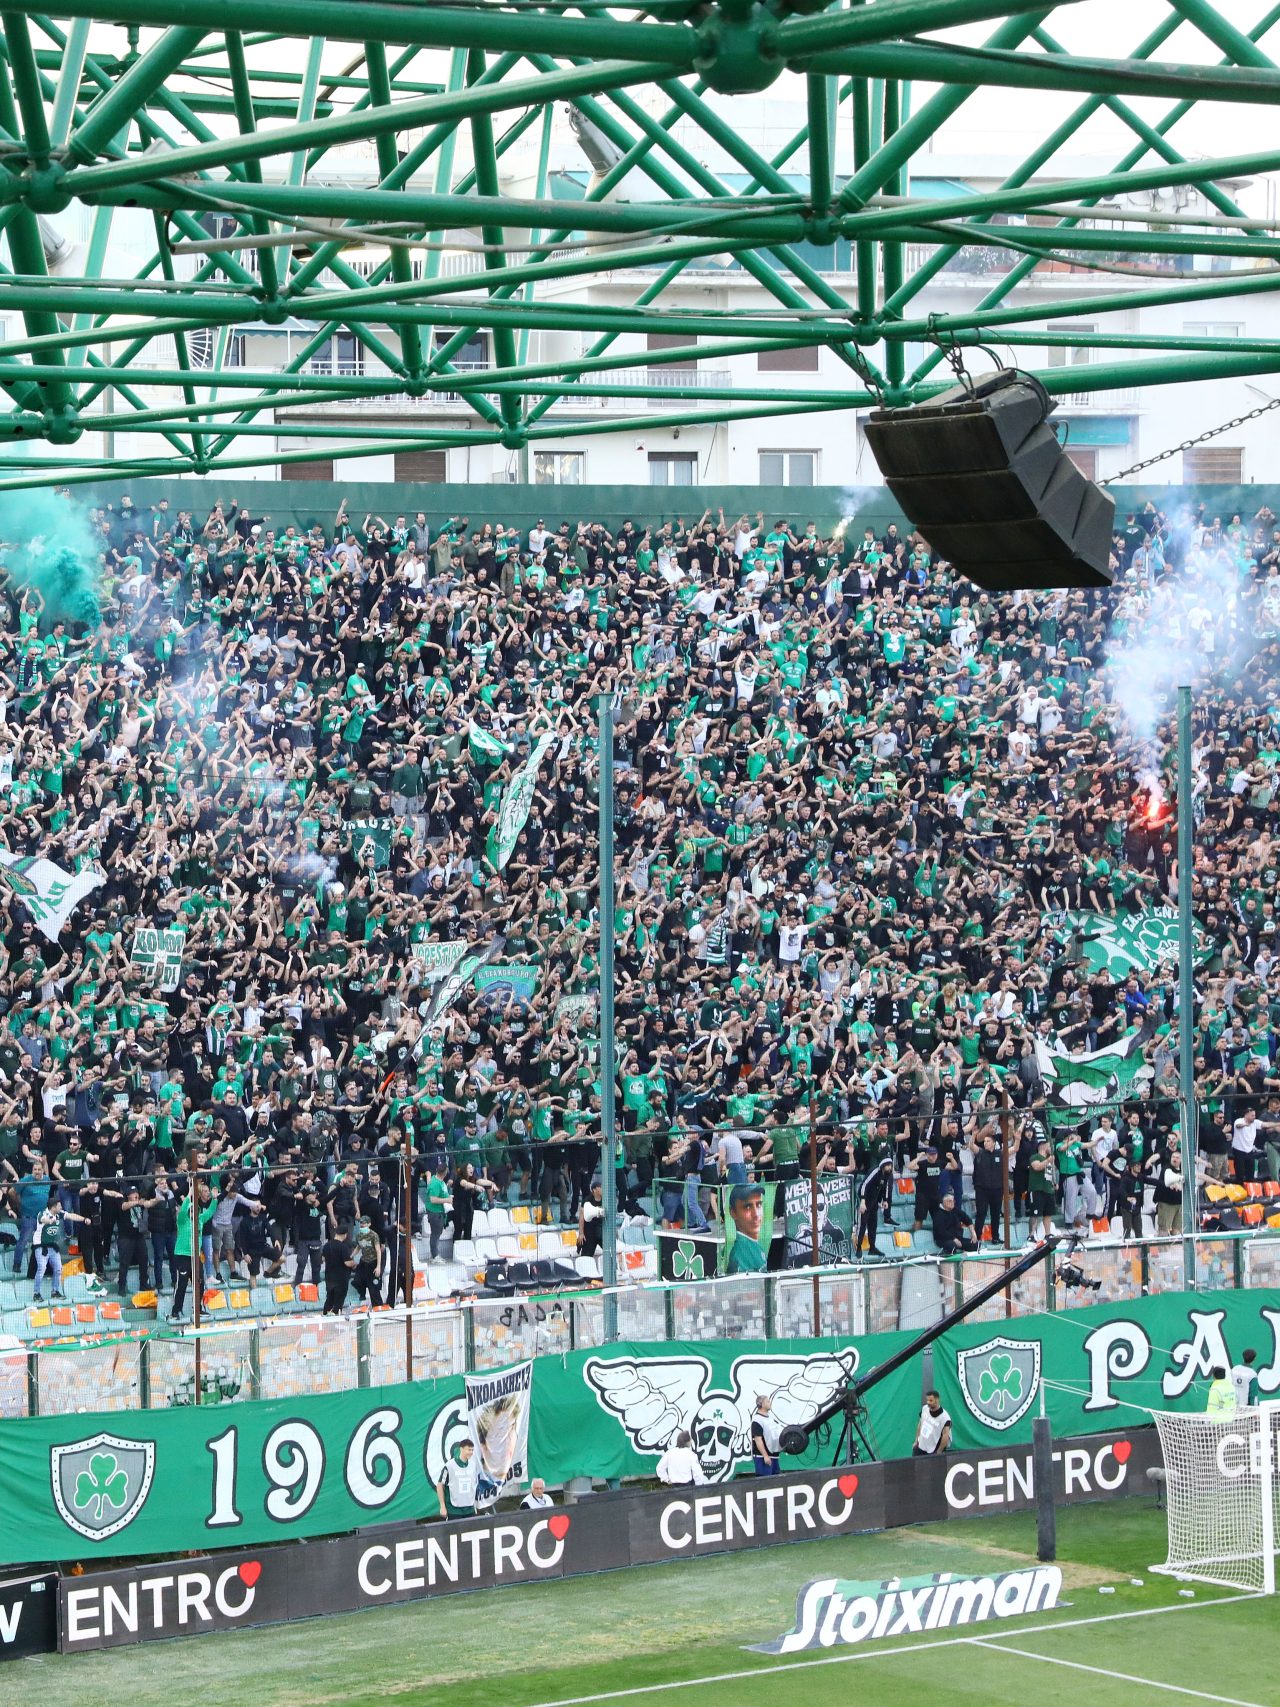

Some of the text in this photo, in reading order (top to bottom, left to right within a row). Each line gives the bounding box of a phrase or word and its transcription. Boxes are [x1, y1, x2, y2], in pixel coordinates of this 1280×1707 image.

[1083, 1304, 1280, 1413] PA
[660, 1478, 853, 1550] CENTRO
[944, 1445, 1127, 1509] CENRO
[357, 1519, 565, 1596] CENTRO
[68, 1565, 257, 1643] ENTRO
[780, 1566, 1063, 1654] Stoiximan
